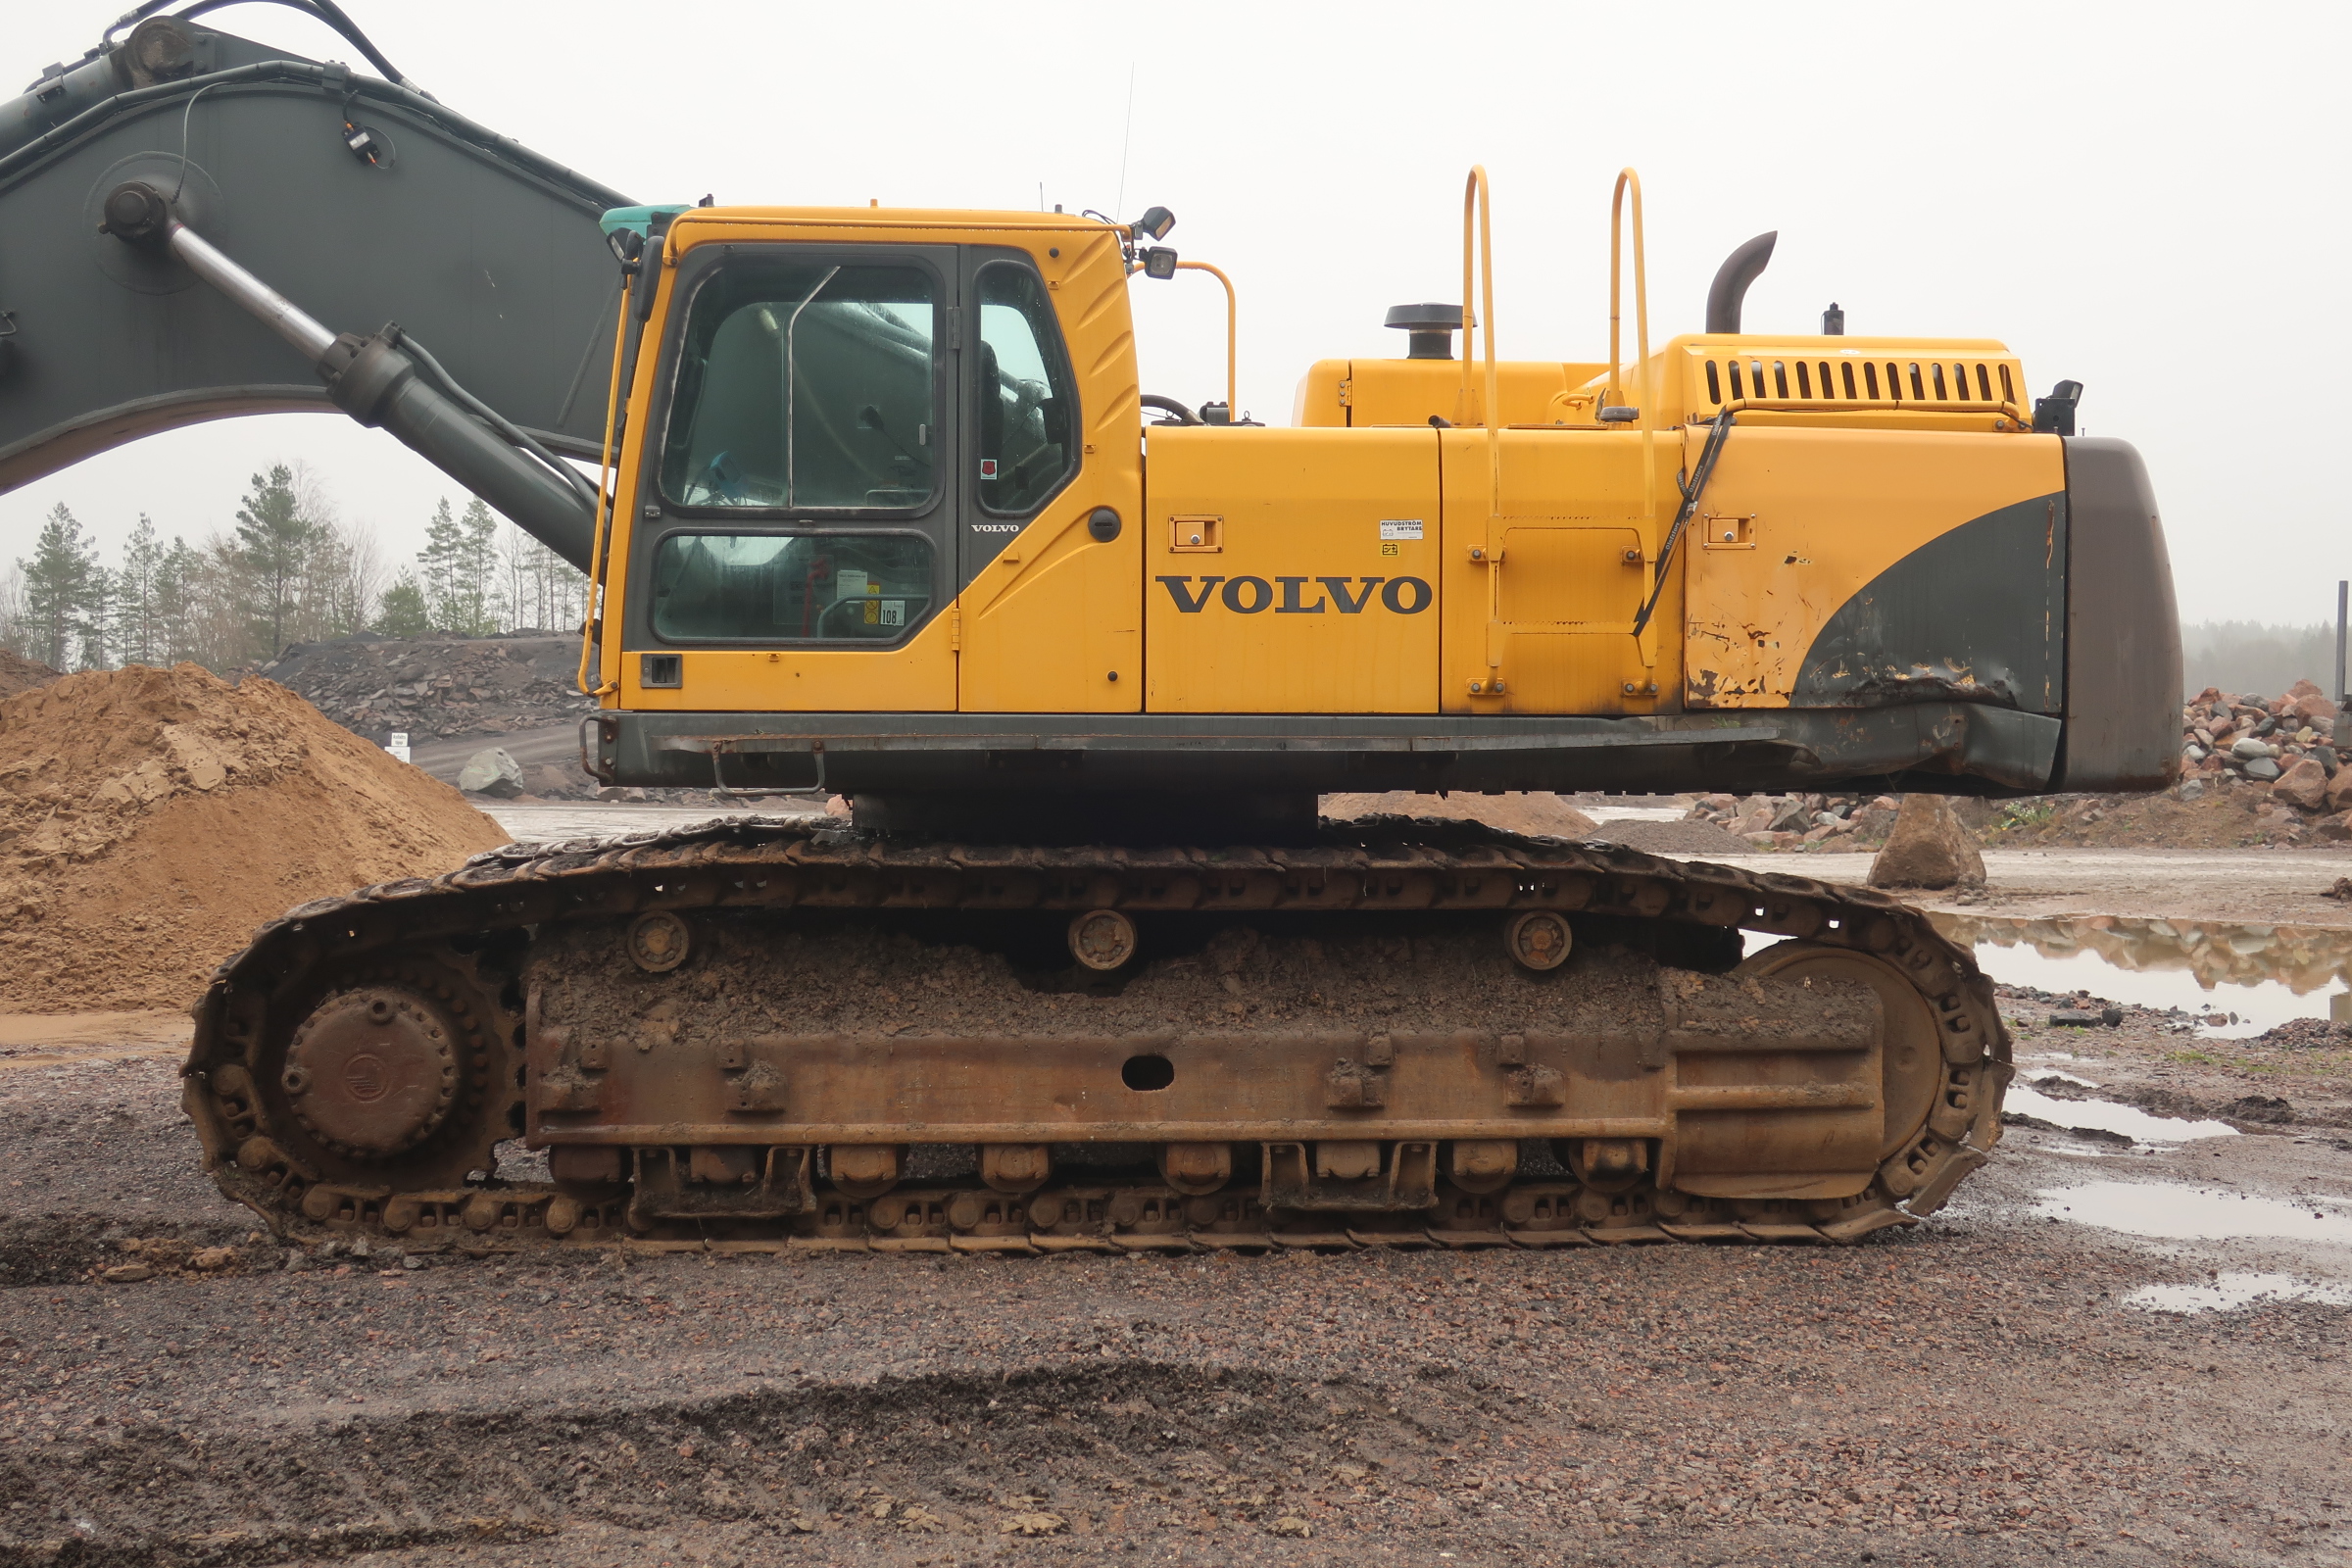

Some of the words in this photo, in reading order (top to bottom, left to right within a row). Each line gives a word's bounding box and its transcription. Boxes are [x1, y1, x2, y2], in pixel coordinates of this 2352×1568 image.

[970, 524, 1020, 533] VOLVO
[1155, 575, 1433, 614] VOLVO
[883, 610, 897, 624] 108
